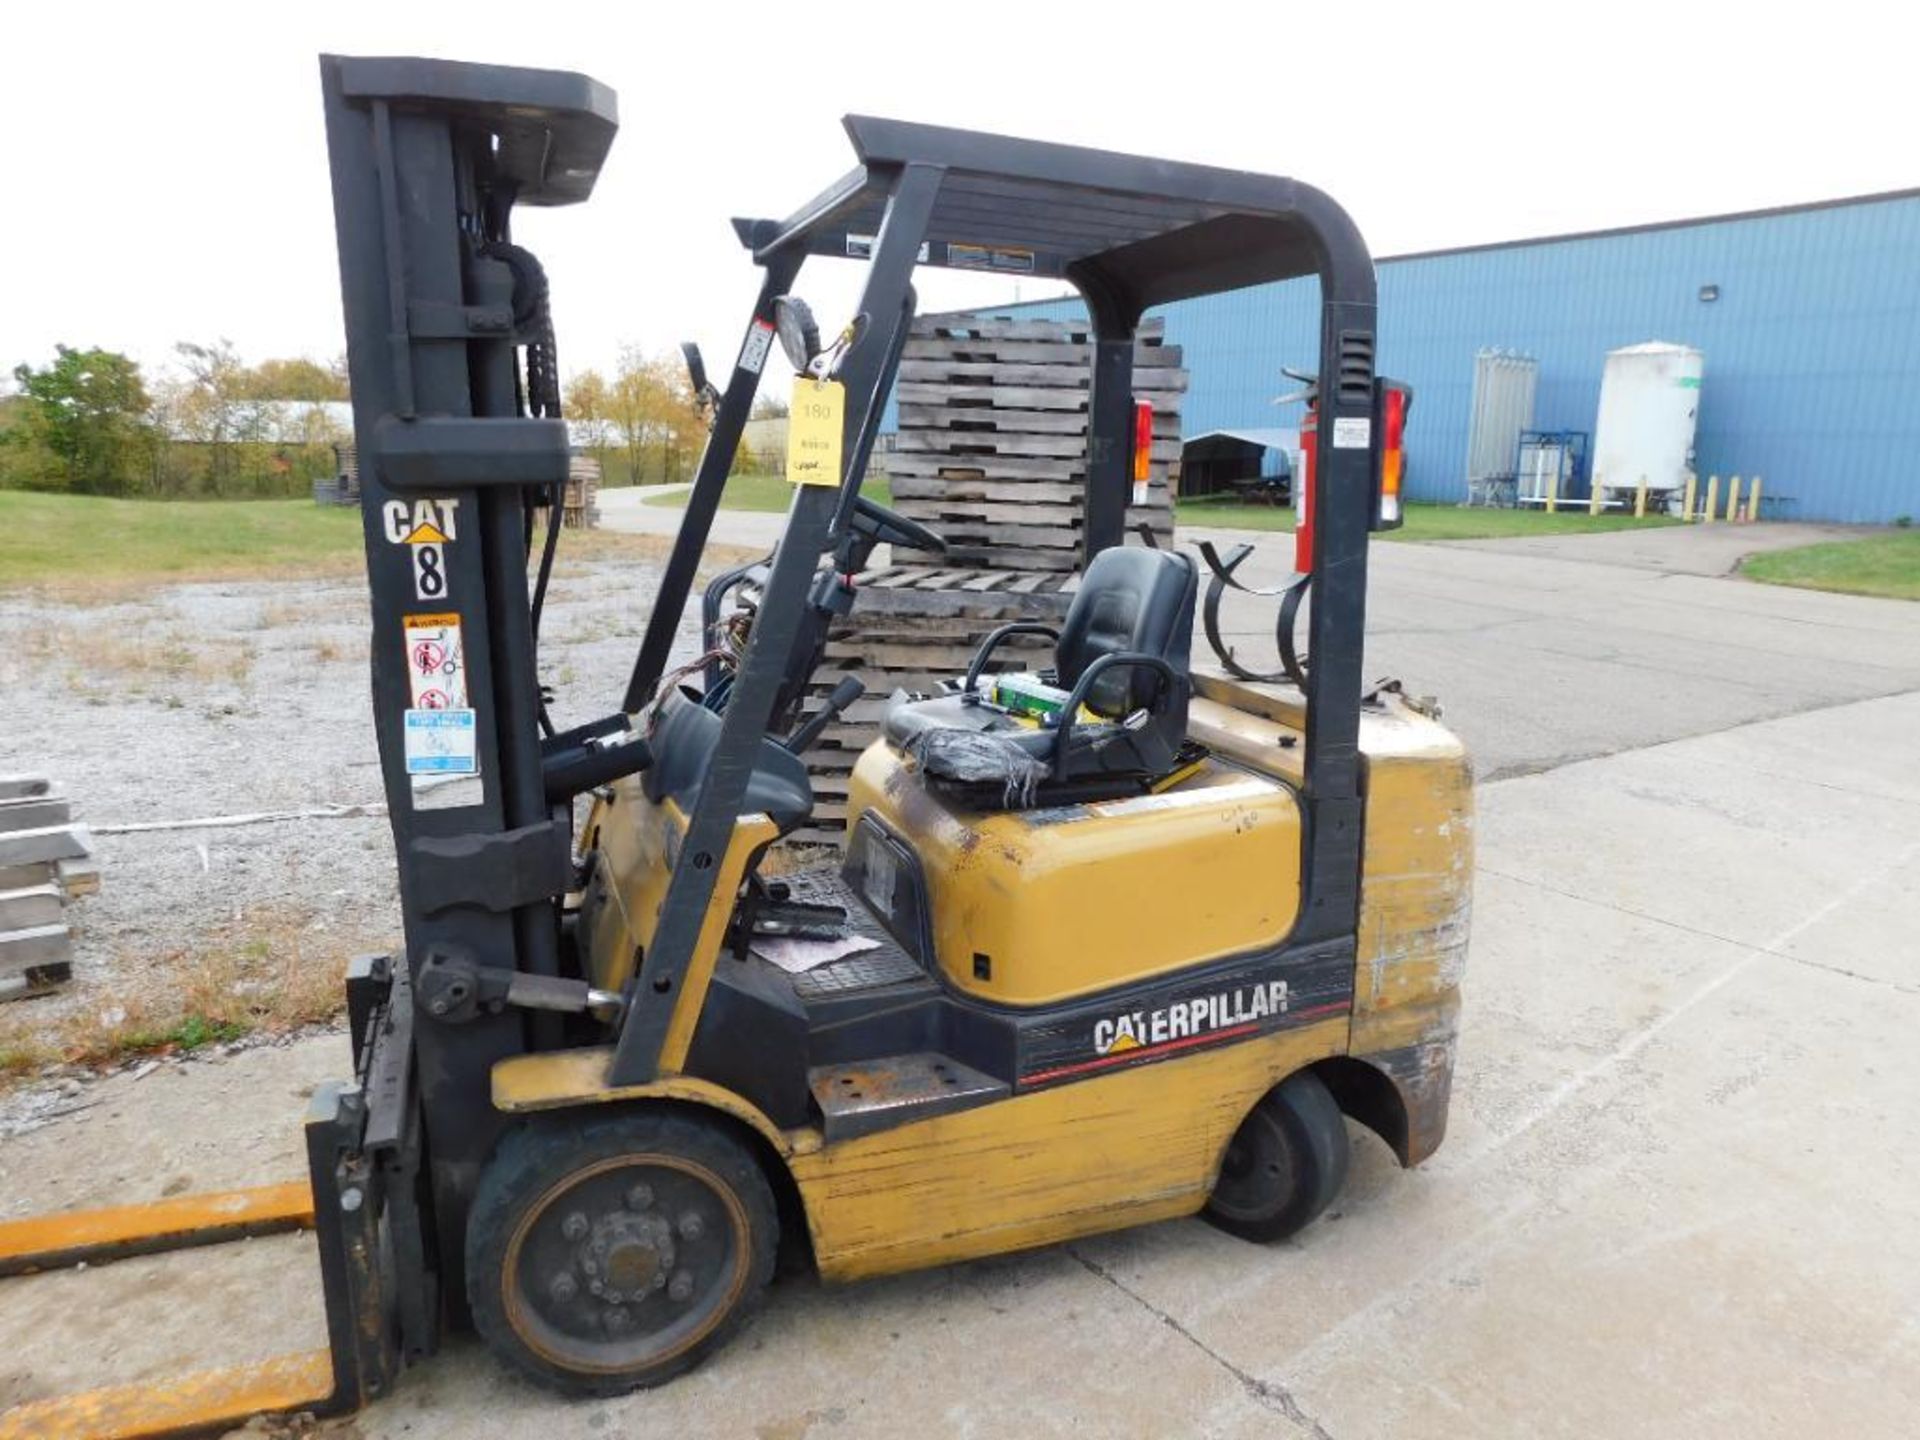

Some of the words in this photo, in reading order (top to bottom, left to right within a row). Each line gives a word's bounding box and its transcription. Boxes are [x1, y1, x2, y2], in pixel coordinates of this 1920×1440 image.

[382, 498, 459, 543] CAT
[418, 546, 442, 596] 8
[1094, 980, 1289, 1054] CATERPILLAR
